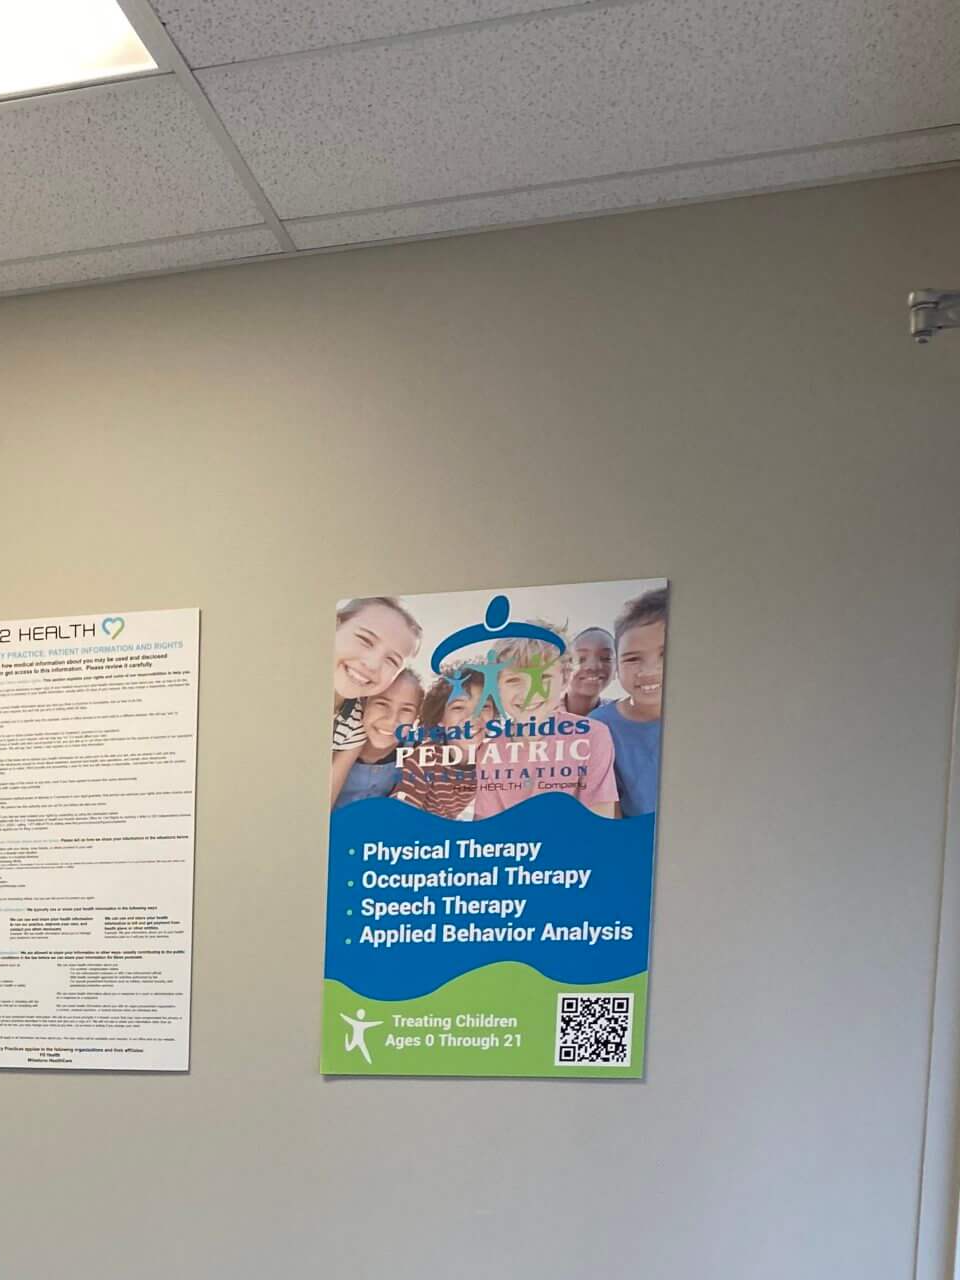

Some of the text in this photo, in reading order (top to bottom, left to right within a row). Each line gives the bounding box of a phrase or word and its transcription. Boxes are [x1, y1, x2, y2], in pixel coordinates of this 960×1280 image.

[19, 624, 95, 641] HEALTH
[48, 647, 79, 656] PATIENT
[81, 644, 134, 653] INFORMATION
[136, 642, 152, 651] AND
[154, 641, 183, 649] RIGHTS
[395, 716, 591, 742] Great Strides
[395, 738, 591, 768] PEDIATRIC
[480, 782, 522, 792] HEALTH
[538, 781, 587, 791] Company
[362, 838, 542, 865] Physical Therapy
[362, 866, 592, 892] Occupational Therapy
[361, 895, 527, 921] Speech Therapy
[359, 921, 634, 948] Applied Behavior Analysis
[392, 1013, 518, 1031] Treating Children
[385, 1033, 522, 1050] Ages 0 Through 21
